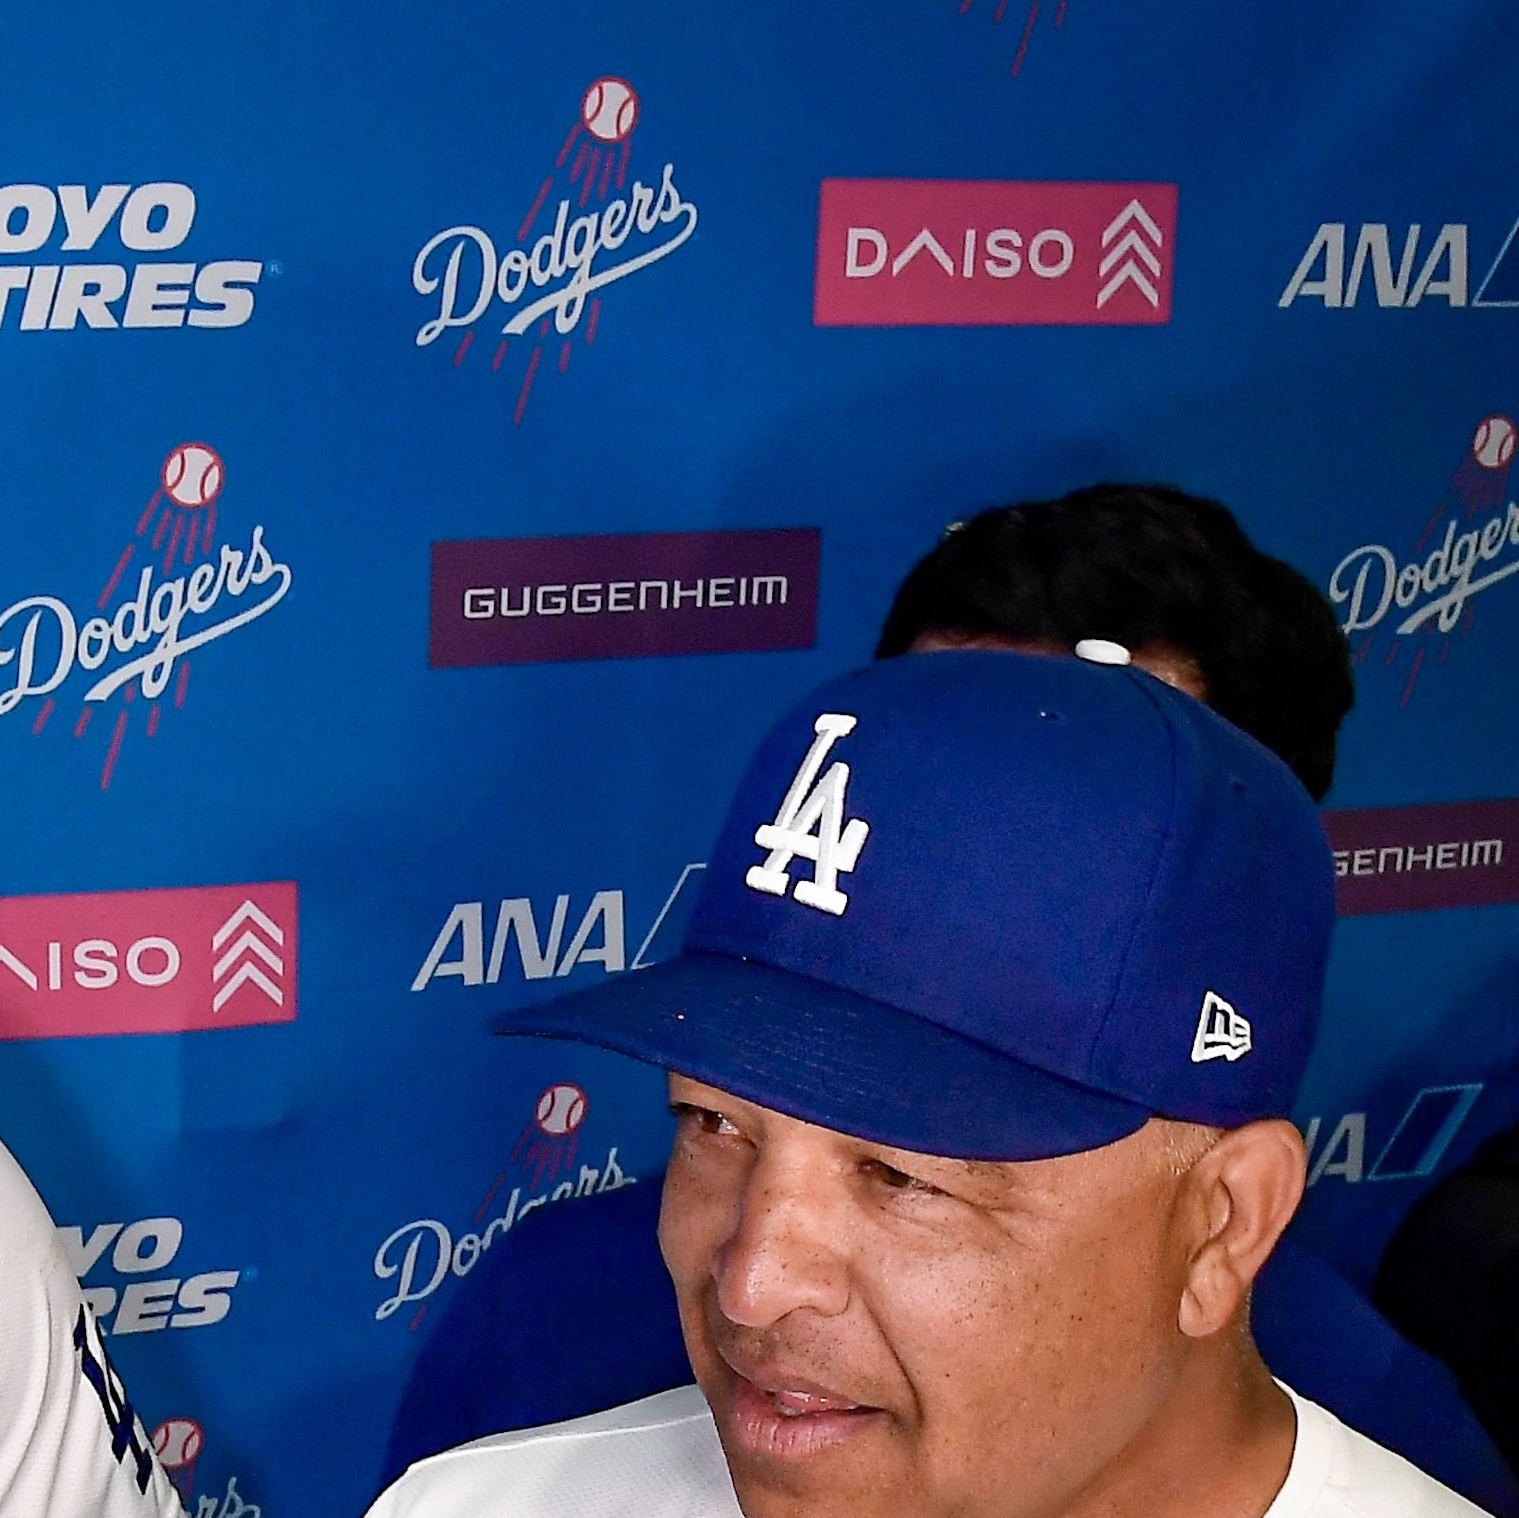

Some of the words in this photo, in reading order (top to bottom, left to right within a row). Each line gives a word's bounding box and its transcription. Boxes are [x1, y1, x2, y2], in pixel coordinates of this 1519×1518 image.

[413, 163, 698, 347] Dodgers
[845, 227, 1076, 279] DAISO
[1278, 223, 1468, 309] ANA
[462, 573, 787, 621] GUGGENHEIM
[746, 713, 870, 916] LA
[411, 890, 626, 992] ANA
[56, 1217, 183, 1274] YO
